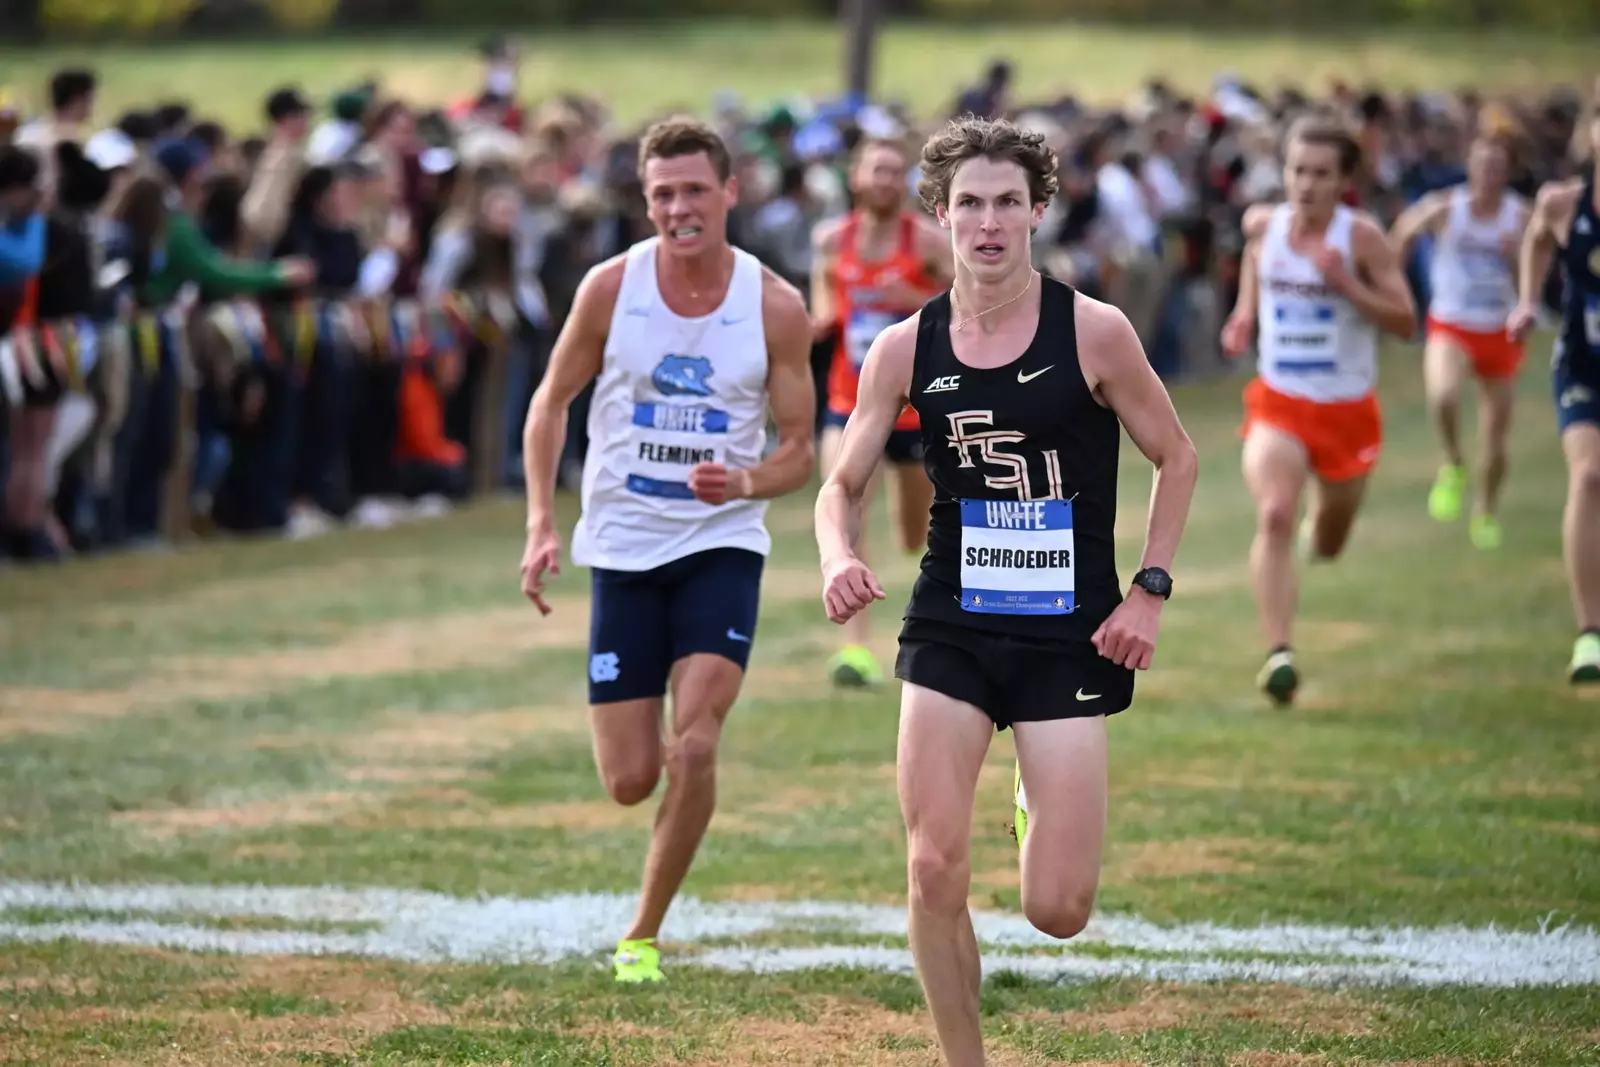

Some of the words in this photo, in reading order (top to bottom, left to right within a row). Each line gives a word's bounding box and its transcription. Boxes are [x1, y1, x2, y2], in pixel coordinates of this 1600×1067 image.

[926, 375, 961, 390] ACC
[655, 405, 702, 432] UNITE
[639, 443, 715, 464] FLEMING
[945, 410, 1064, 501] FSU
[985, 501, 1047, 530] UNITE
[965, 547, 1070, 569] SCHROEDER
